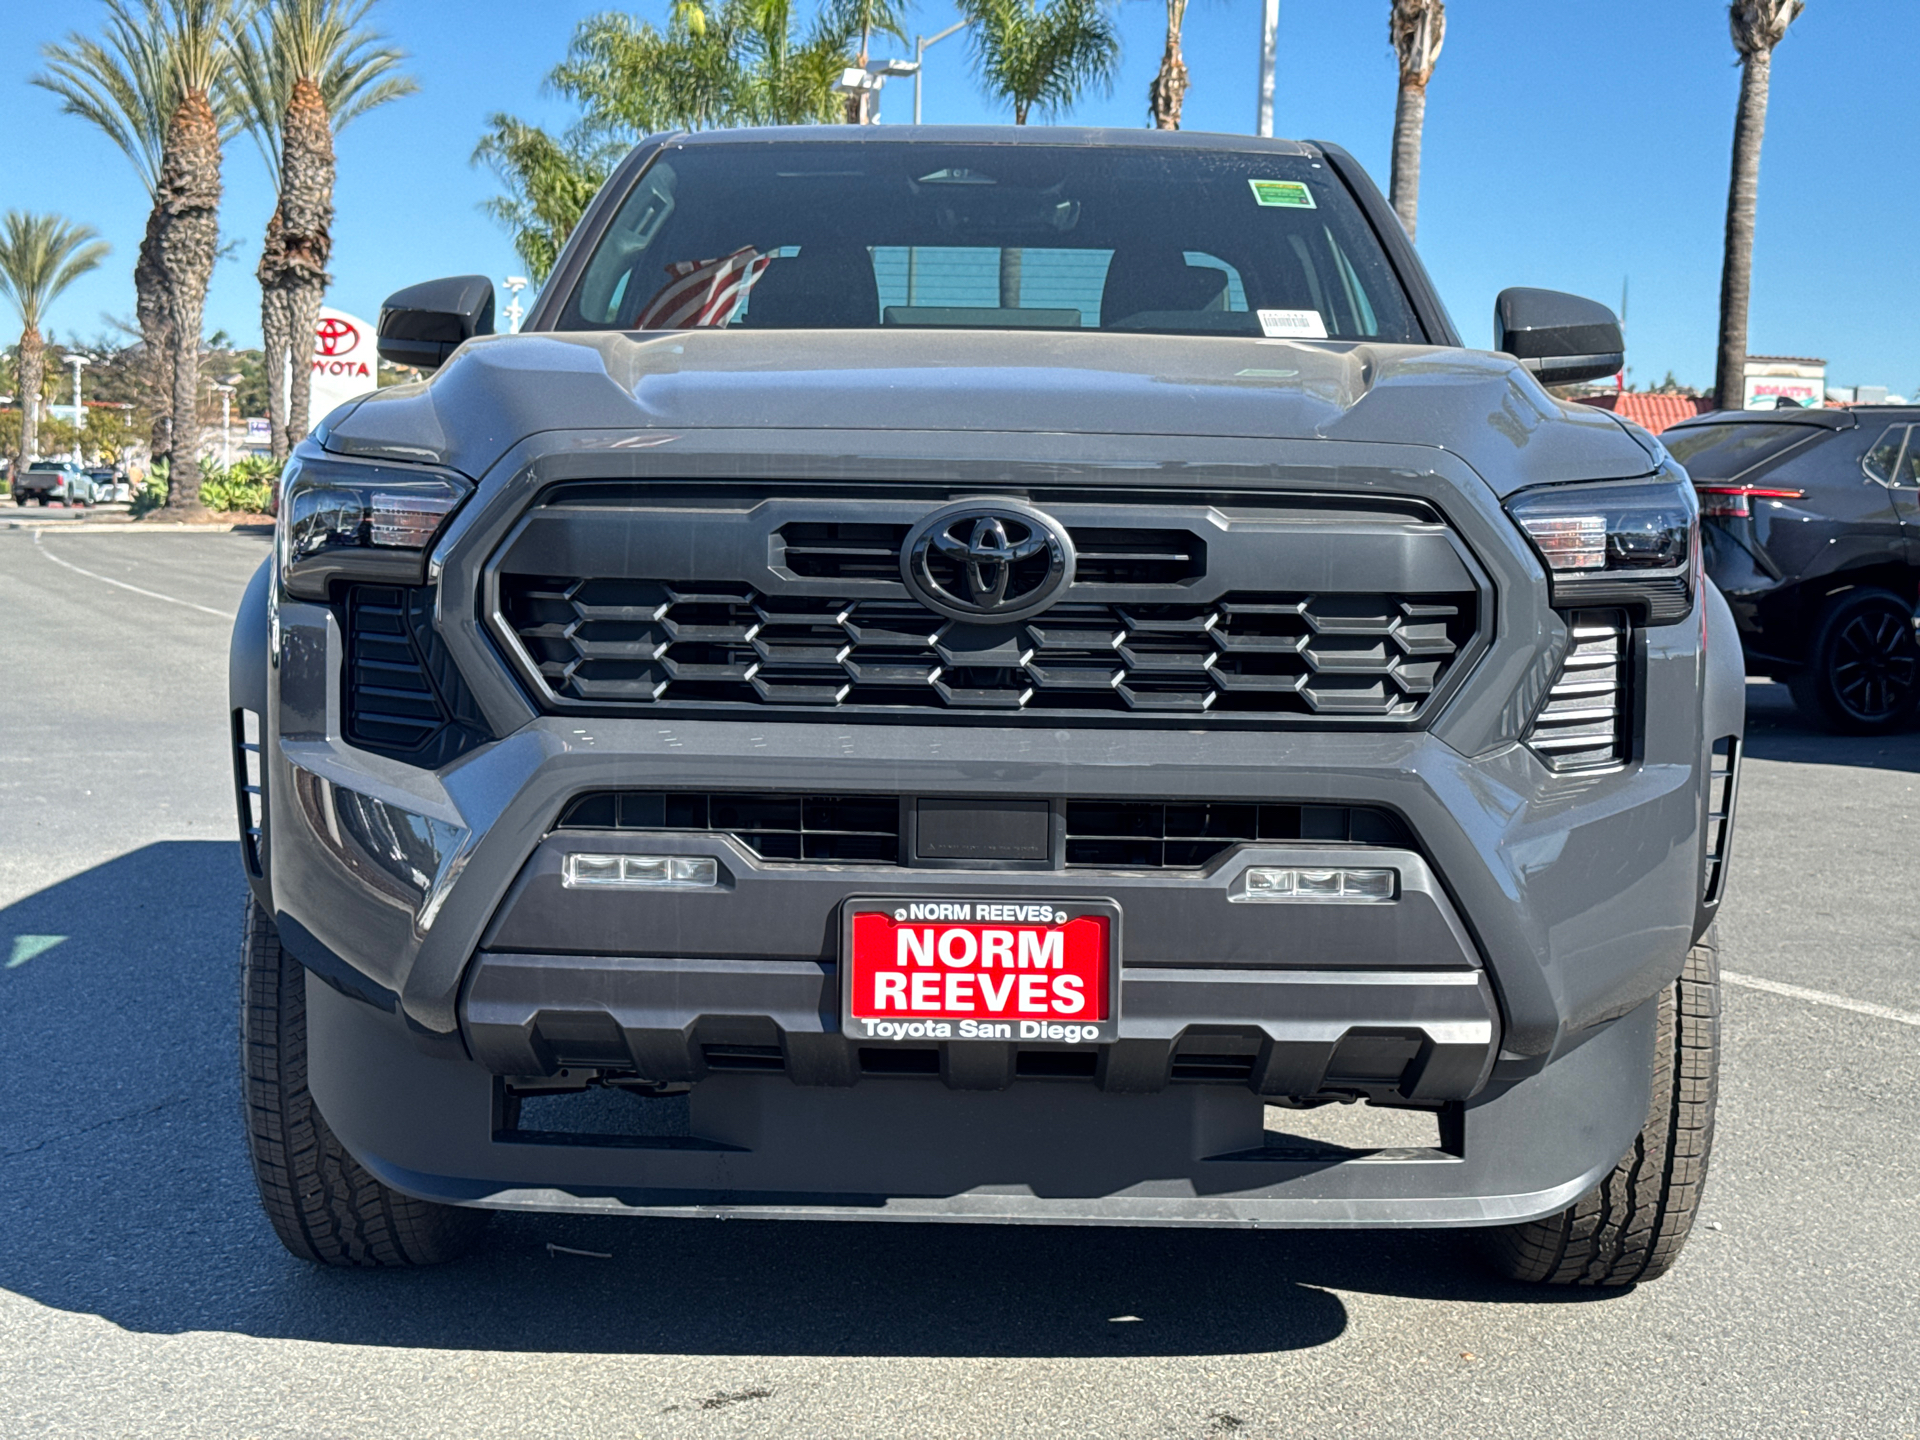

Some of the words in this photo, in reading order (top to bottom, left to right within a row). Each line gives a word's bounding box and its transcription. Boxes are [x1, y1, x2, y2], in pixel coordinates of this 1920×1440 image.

[311, 360, 370, 377] YOTA
[909, 904, 971, 921] NORM
[976, 904, 1053, 922] REEVES
[897, 928, 1064, 969] NORM
[874, 972, 1085, 1014] REEVES
[861, 1018, 951, 1041] Toyota
[958, 1020, 1011, 1039] San
[1020, 1020, 1099, 1043] Diego
